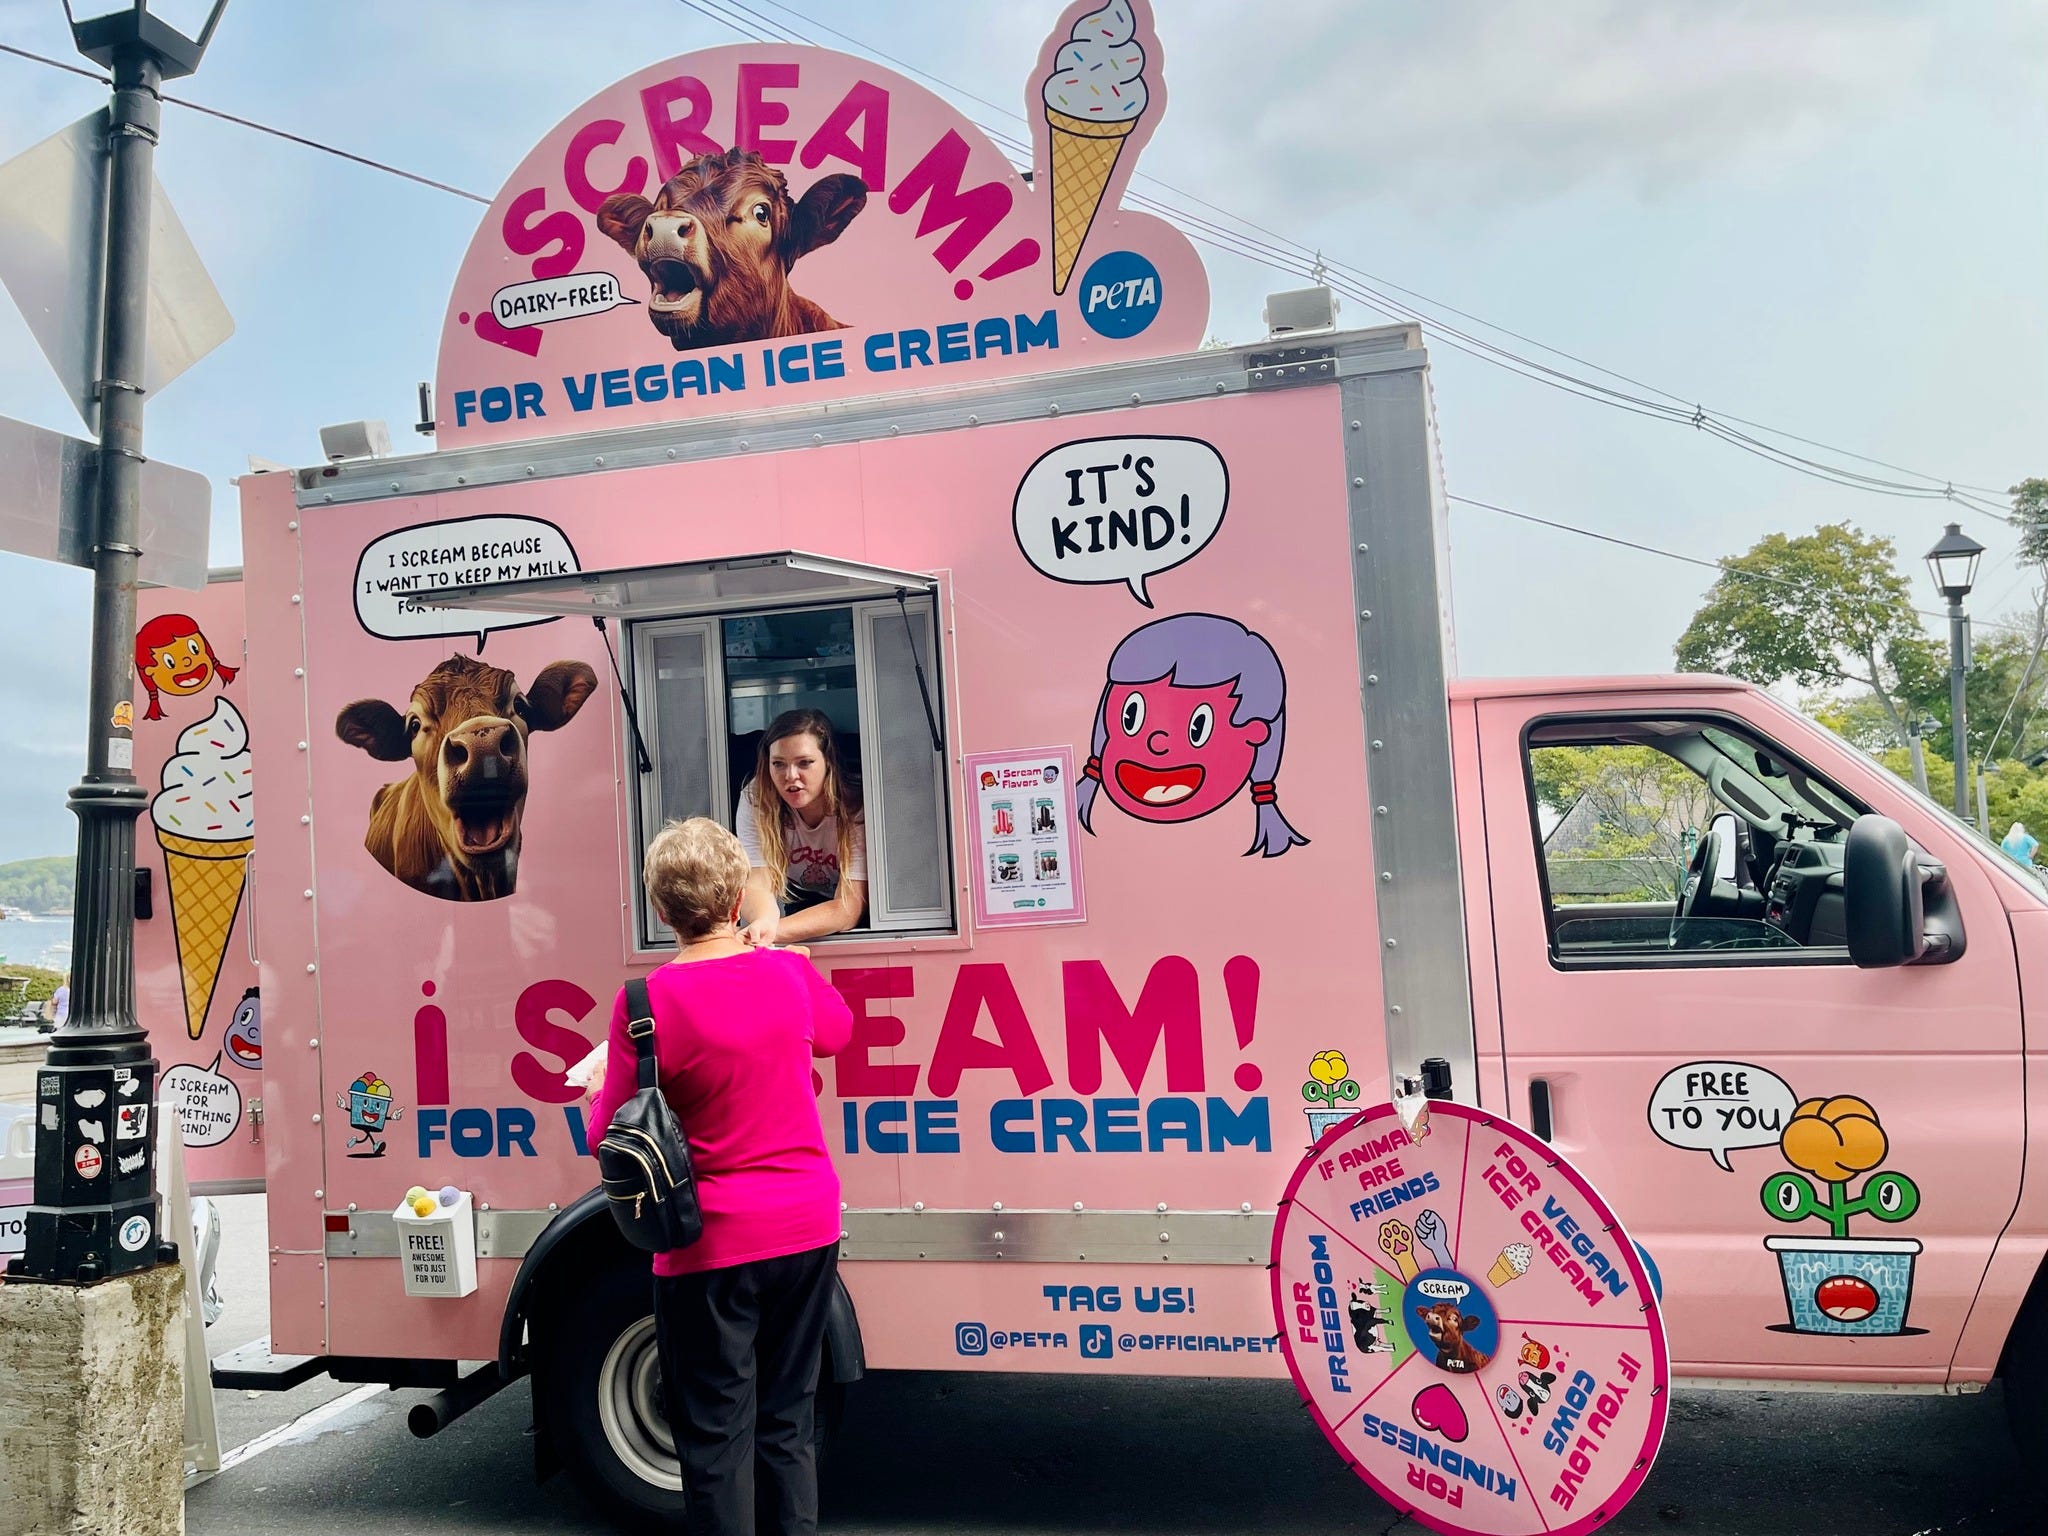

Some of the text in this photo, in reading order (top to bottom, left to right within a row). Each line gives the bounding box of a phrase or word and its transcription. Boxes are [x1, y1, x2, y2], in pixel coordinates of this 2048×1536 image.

[502, 63, 1041, 301] SCREAM!
[499, 281, 614, 319] DAIRY-FREE!
[454, 310, 1060, 427] FOR VEGAN ICE CREAM
[1064, 453, 1156, 507] IT'S
[1051, 493, 1191, 560] KIND!
[388, 537, 542, 568] I SCREAM BECAUSE
[366, 560, 568, 593] I WANT TO KEEP MY MILK
[997, 768, 1042, 778] I Scream
[1002, 779, 1039, 789] Flavors
[511, 954, 1263, 1105] SEAM!
[171, 1078, 229, 1096] I SCREAM
[186, 1094, 208, 1107] FOR
[1686, 1071, 1750, 1097] FREE
[178, 1107, 231, 1124] METHING
[417, 1107, 536, 1158] FOR
[843, 1100, 960, 1154] ICE
[990, 1096, 1272, 1153] CREAM
[1661, 1106, 1781, 1132] TO YOU
[1318, 1126, 1431, 1181] IF ANIMA
[1358, 1157, 1405, 1191] ARE
[1349, 1171, 1441, 1222] FRIENDS
[1481, 1164, 1605, 1308] ICE CREAM
[1493, 1142, 1629, 1297] FOR VEGAN
[408, 1235, 445, 1250] FREE!
[412, 1253, 446, 1262] AWESOME
[413, 1264, 446, 1273] INFO JUST
[415, 1274, 429, 1283] FOR
[1043, 1285, 1195, 1313] TAG US!
[1423, 1282, 1465, 1296] SCREAM
[1293, 1281, 1318, 1344] FOR
[1308, 1235, 1352, 1393] FREEDOM
[990, 1331, 1068, 1348] @PETA
[1543, 1370, 1596, 1457] COWS
[1550, 1351, 1642, 1512] IF YOU LOVE
[1362, 1413, 1517, 1502] KINDNESS
[1406, 1462, 1464, 1509] FOR
